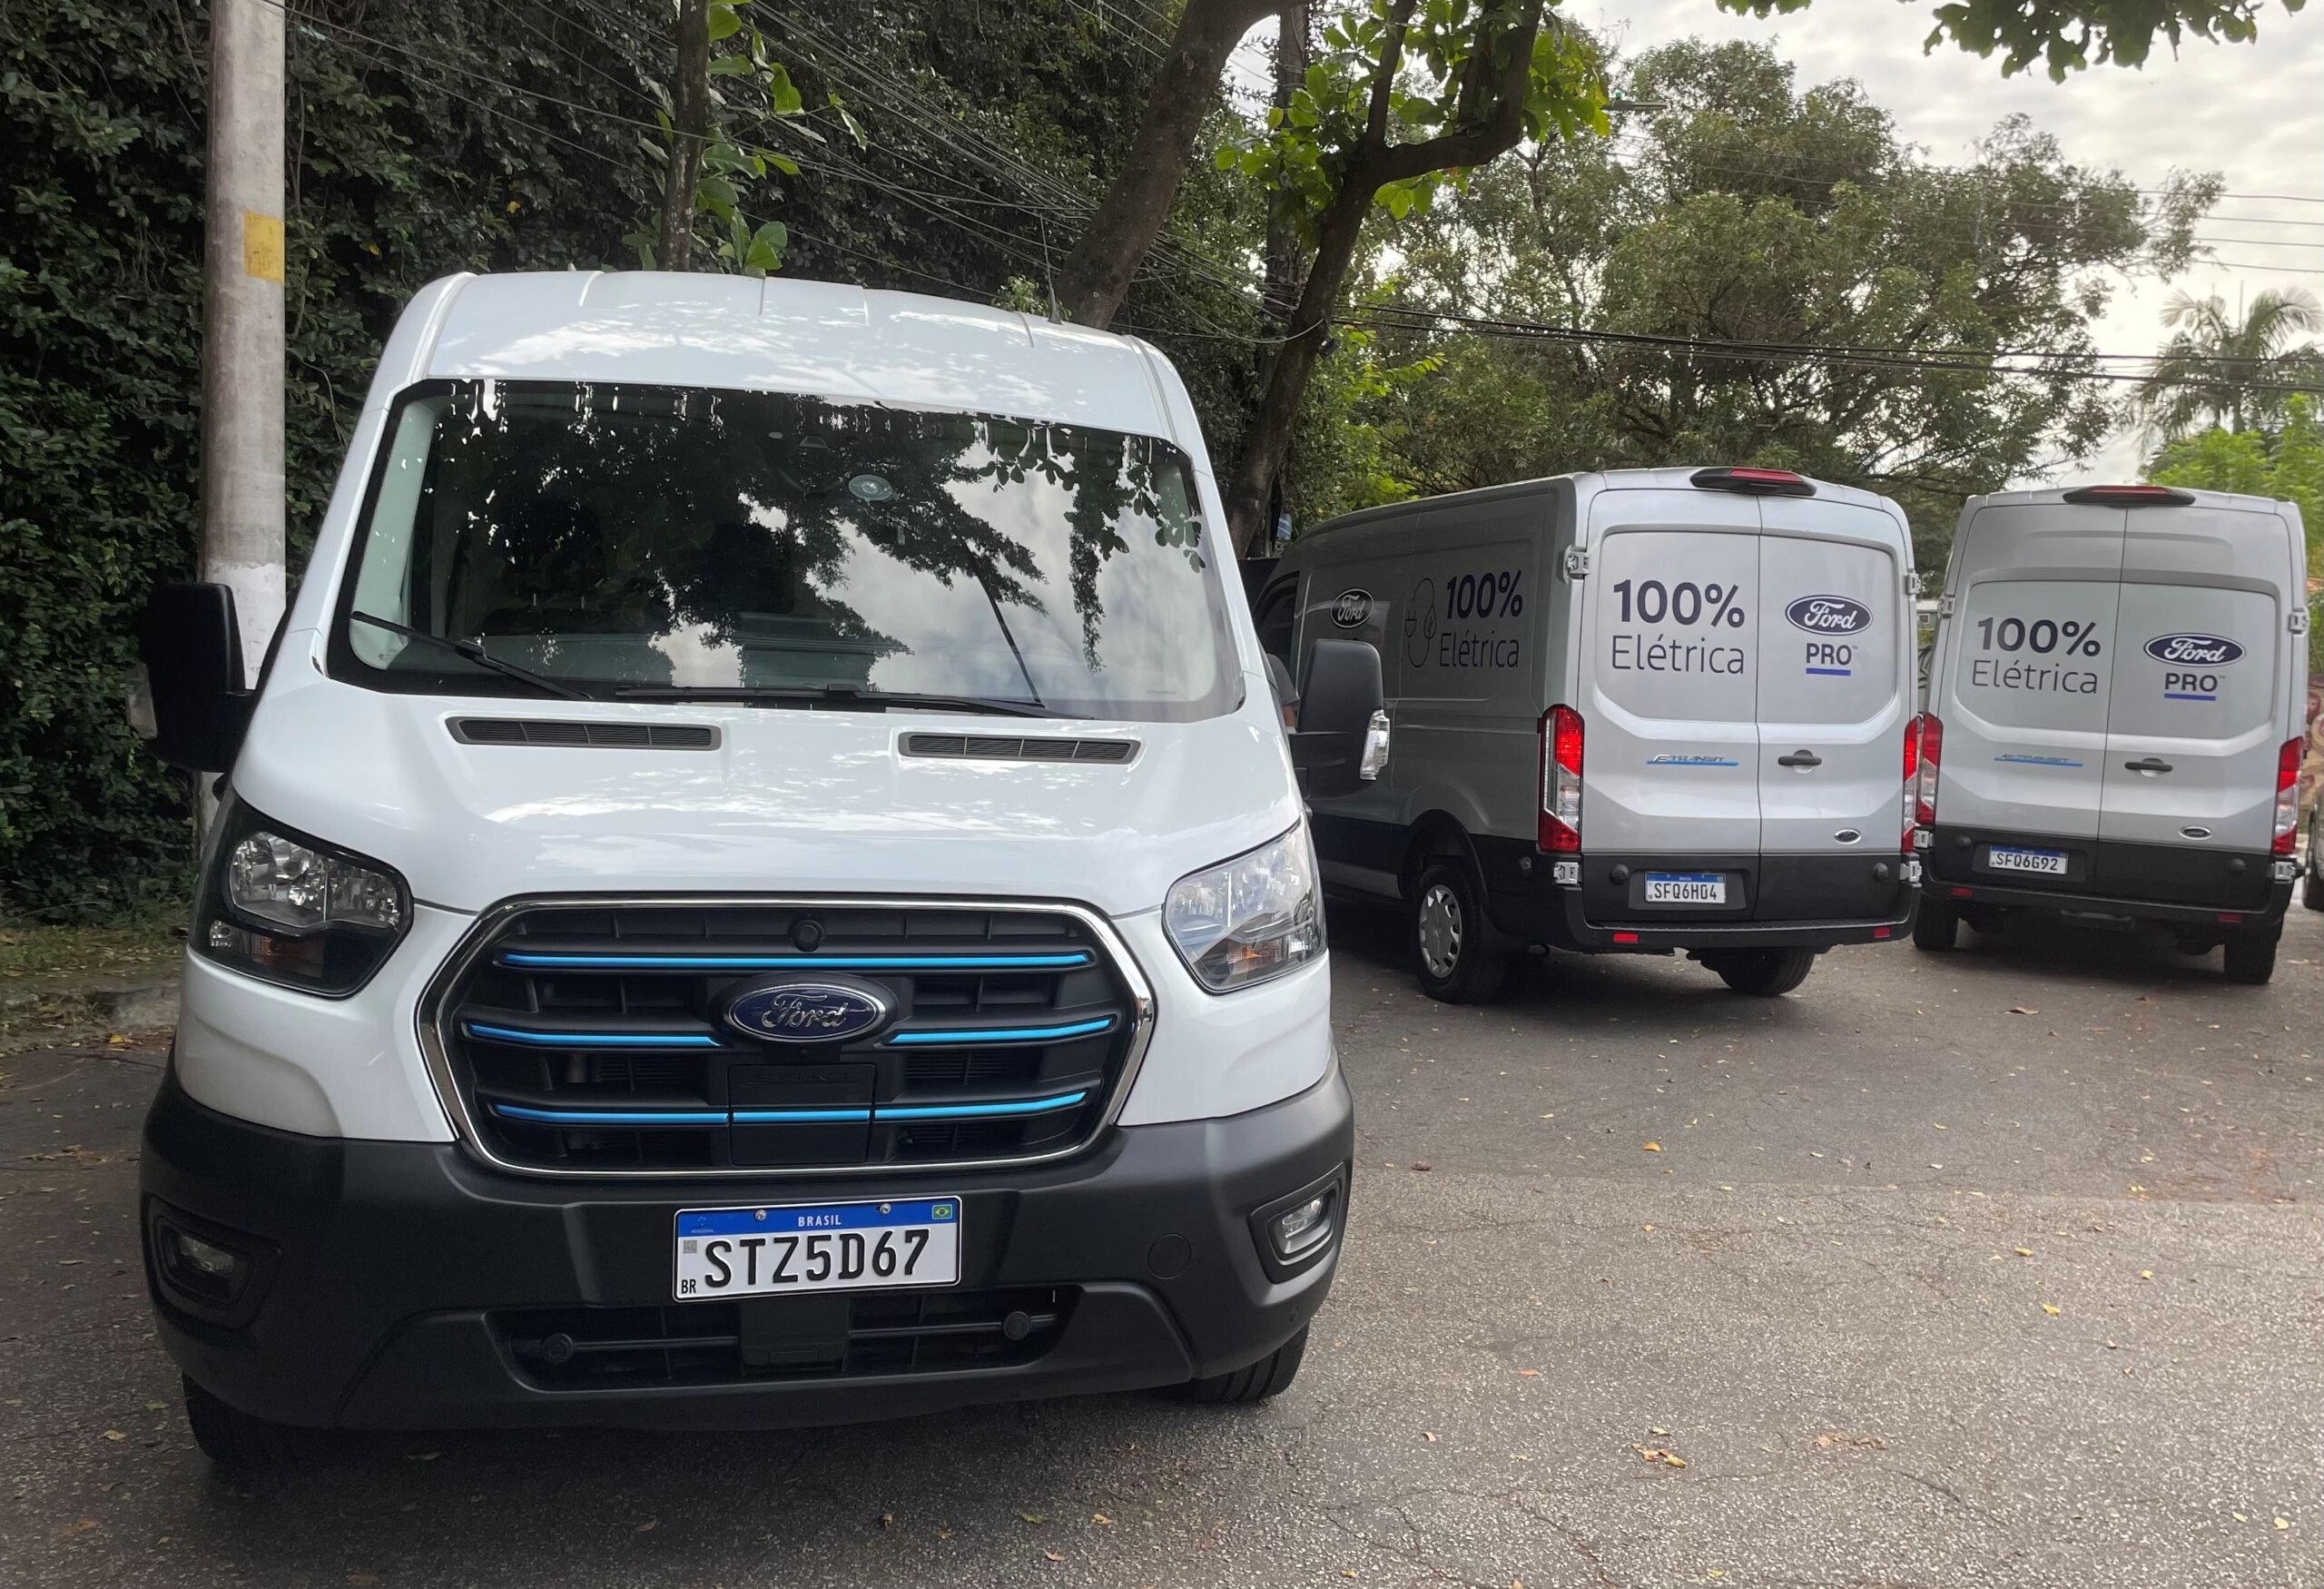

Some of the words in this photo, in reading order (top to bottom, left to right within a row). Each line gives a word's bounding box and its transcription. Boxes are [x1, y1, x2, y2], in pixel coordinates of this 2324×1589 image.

[1337, 594, 1366, 621] Ford
[1446, 568, 1523, 619] 100%
[1613, 578, 1745, 628] 100%
[1804, 600, 1858, 629] Ford
[1439, 628, 1520, 668] Elétrica
[1611, 634, 1745, 675] Elétrica
[1977, 617, 2102, 657] 100%
[2163, 637, 2228, 662] Ford
[1972, 659, 2098, 695] Elétrica
[1995, 853, 2059, 872] SFQ6G92
[761, 993, 850, 1029] Ford
[798, 1214, 842, 1227] BRASIL
[704, 1229, 930, 1288] STZ5D67
[681, 1278, 696, 1294] BR
